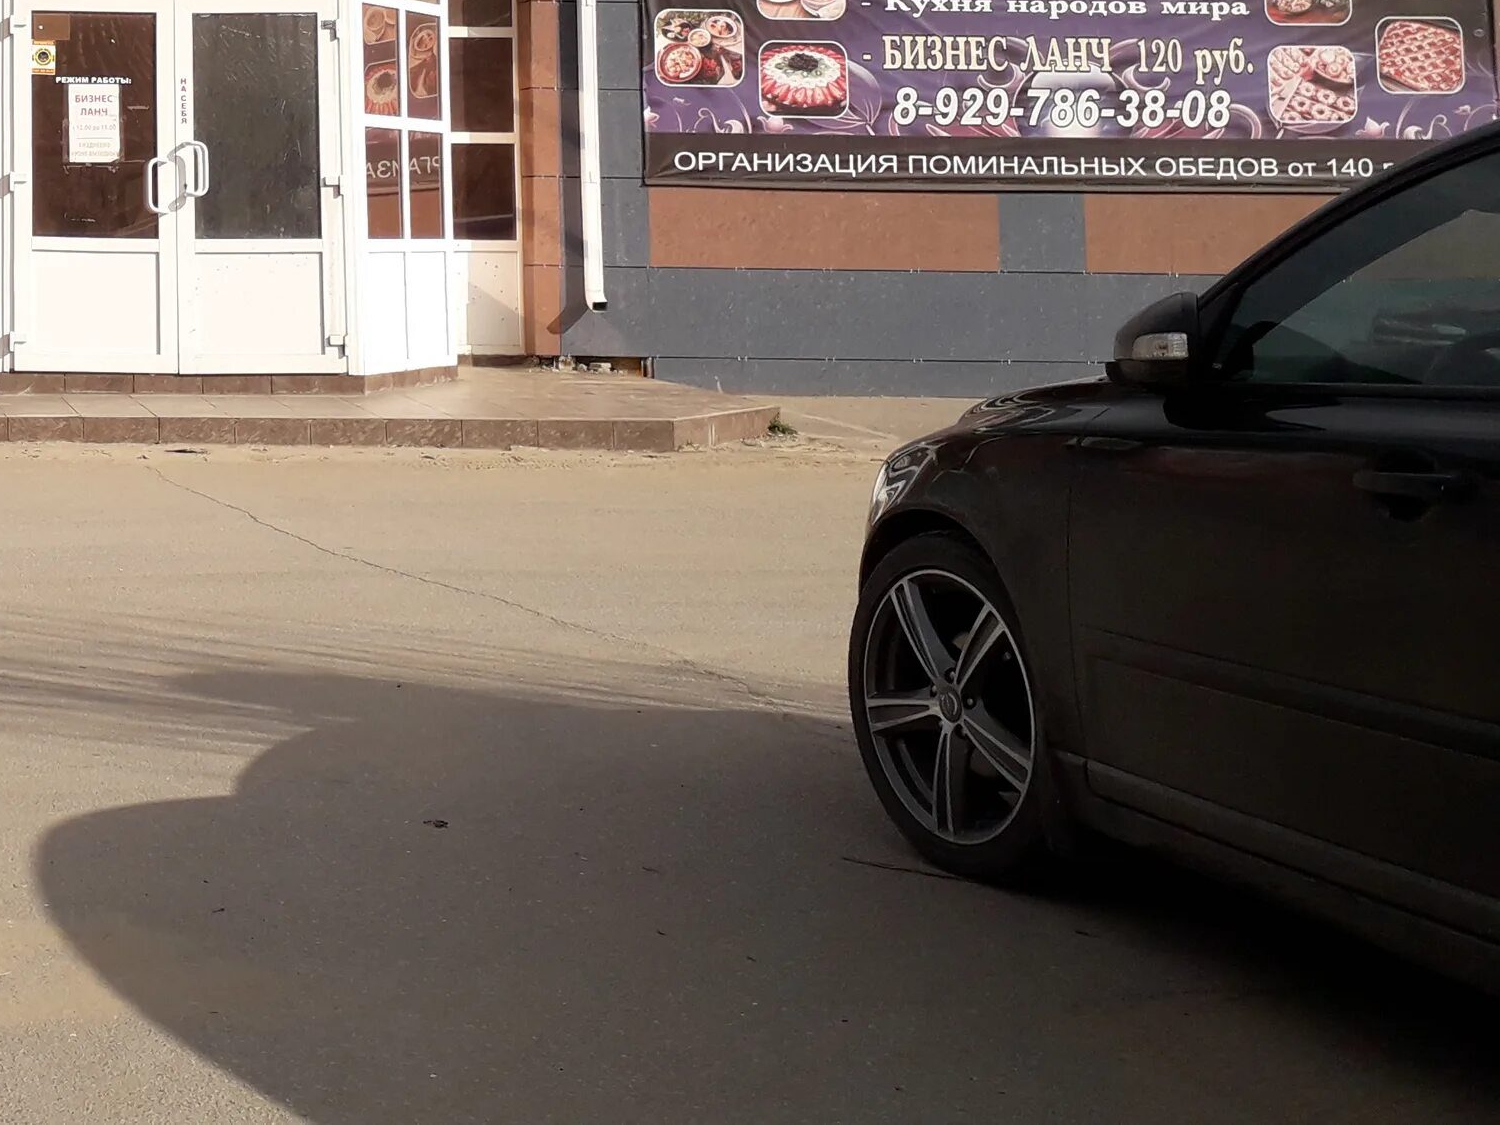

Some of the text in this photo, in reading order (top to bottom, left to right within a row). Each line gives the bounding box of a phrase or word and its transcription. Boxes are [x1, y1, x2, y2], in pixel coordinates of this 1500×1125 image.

[1006, 0, 1147, 20] народов
[1160, 1, 1251, 21] мира
[881, 35, 1009, 72] БИЗНЕС
[1019, 35, 1113, 73] ЛАНЧ
[1136, 38, 1183, 73] 120
[1193, 37, 1255, 85] руб.
[55, 76, 132, 85] РЕЖИМ РАБОТЫ:
[74, 94, 114, 103] БИЗНЕС
[79, 107, 109, 116] ЛАНЧ
[180, 94, 188, 125] СЕБЯ
[893, 86, 1231, 128] 8-929-786-38-08
[673, 150, 898, 178] ОРГАНИЗАЦИЯ
[908, 153, 1145, 178] ПОМИНАЛЬНЫХ
[1154, 157, 1279, 181] ОБЕДОВ
[1287, 161, 1317, 178] от
[1326, 157, 1374, 178] 140
